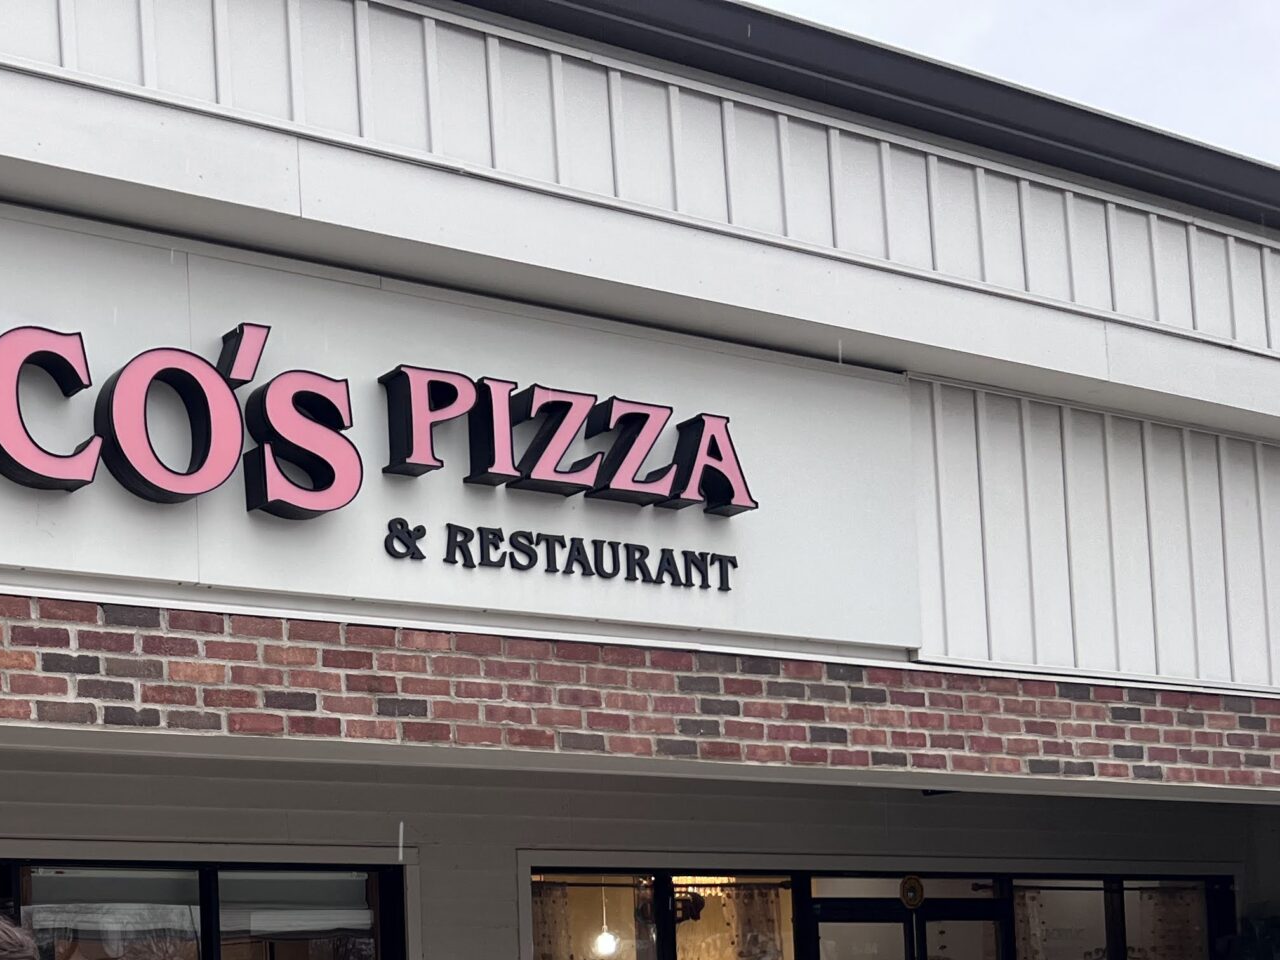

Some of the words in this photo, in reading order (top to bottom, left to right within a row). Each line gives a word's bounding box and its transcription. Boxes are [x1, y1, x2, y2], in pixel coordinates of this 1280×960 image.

[376, 361, 760, 518] PIZZA
[384, 517, 425, 562] &
[443, 523, 738, 591] RESTAURANT
